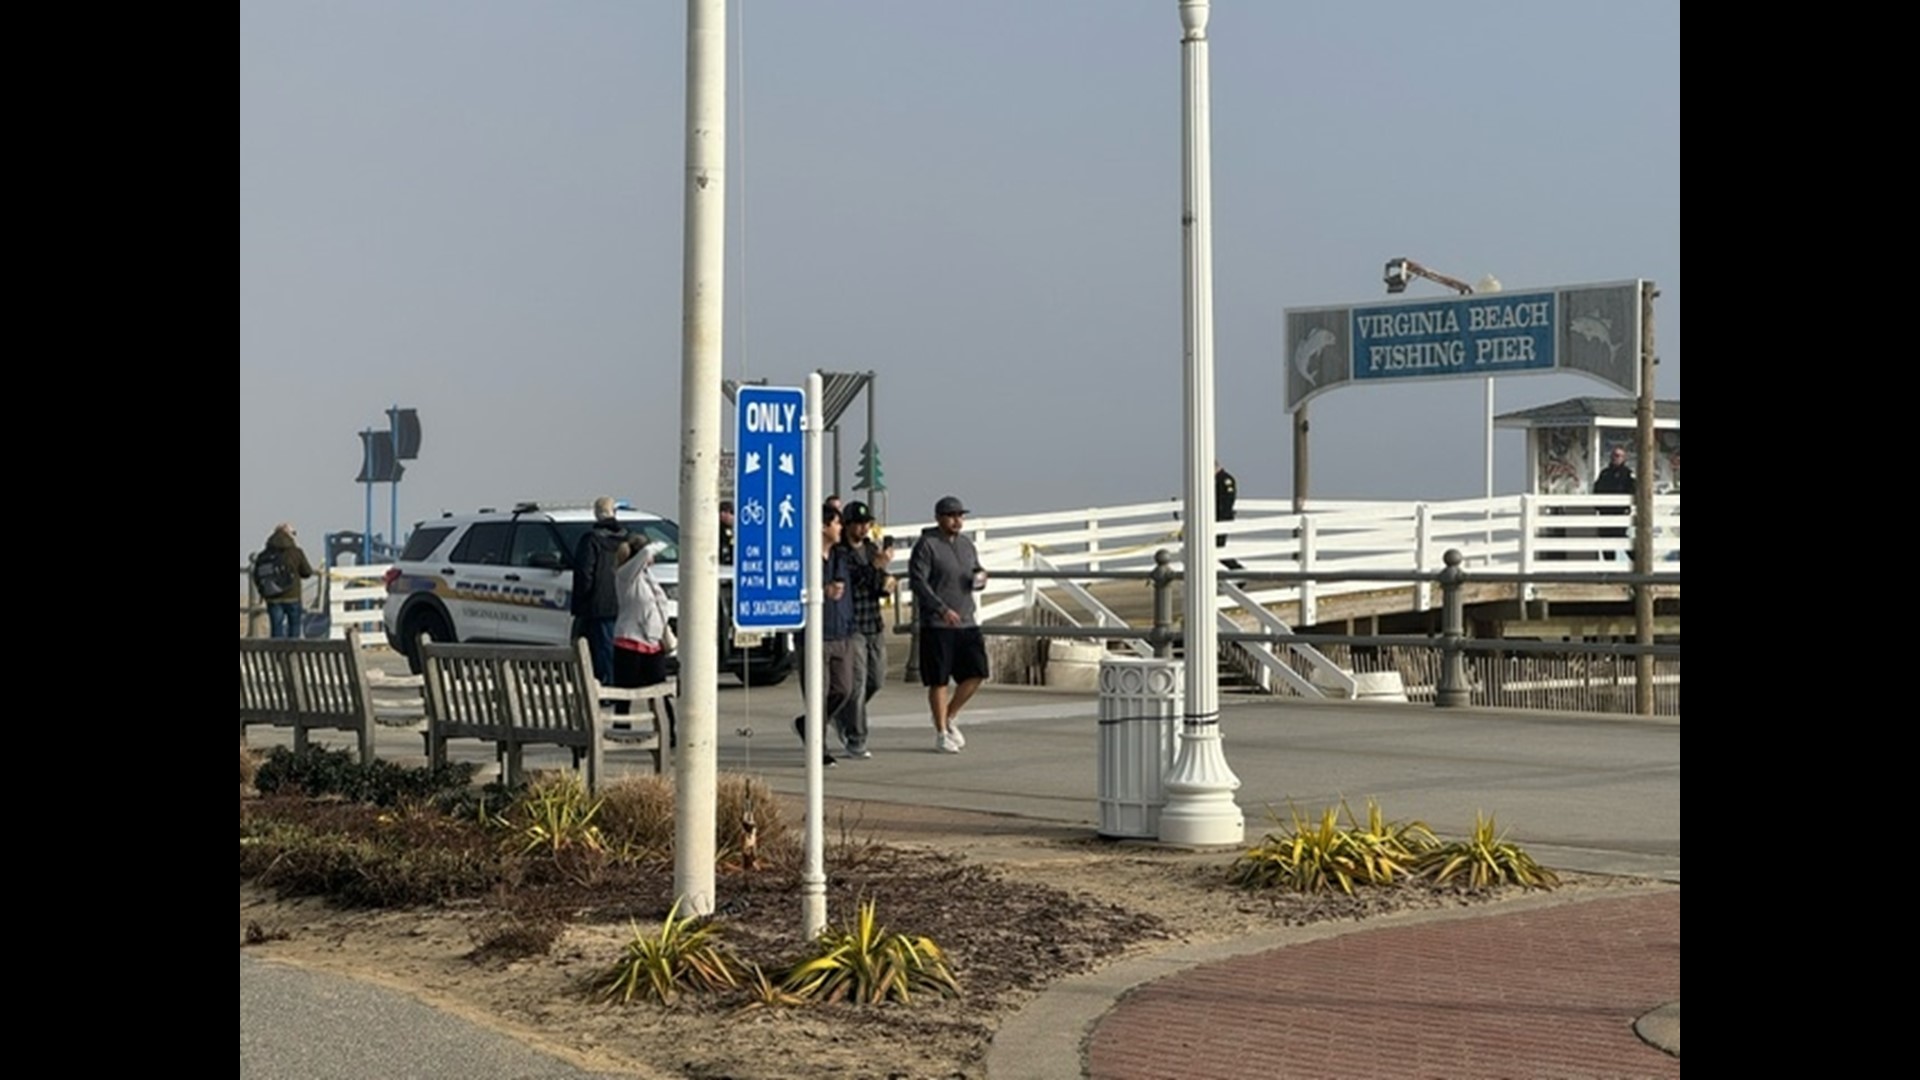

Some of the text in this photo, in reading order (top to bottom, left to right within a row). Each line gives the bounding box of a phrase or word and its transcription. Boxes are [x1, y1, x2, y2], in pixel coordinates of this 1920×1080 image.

[1357, 302, 1550, 339] VIRGINIA BEACH
[1369, 335, 1536, 371] FISHING PIER
[746, 402, 796, 433] ONLY
[745, 545, 760, 557] ON
[781, 545, 792, 557] ON
[742, 560, 763, 572] BIKE
[774, 560, 800, 572] BOARD
[740, 575, 764, 587] PATH
[776, 575, 797, 587] WALK
[740, 600, 800, 615] NO SKATEBOARDS
